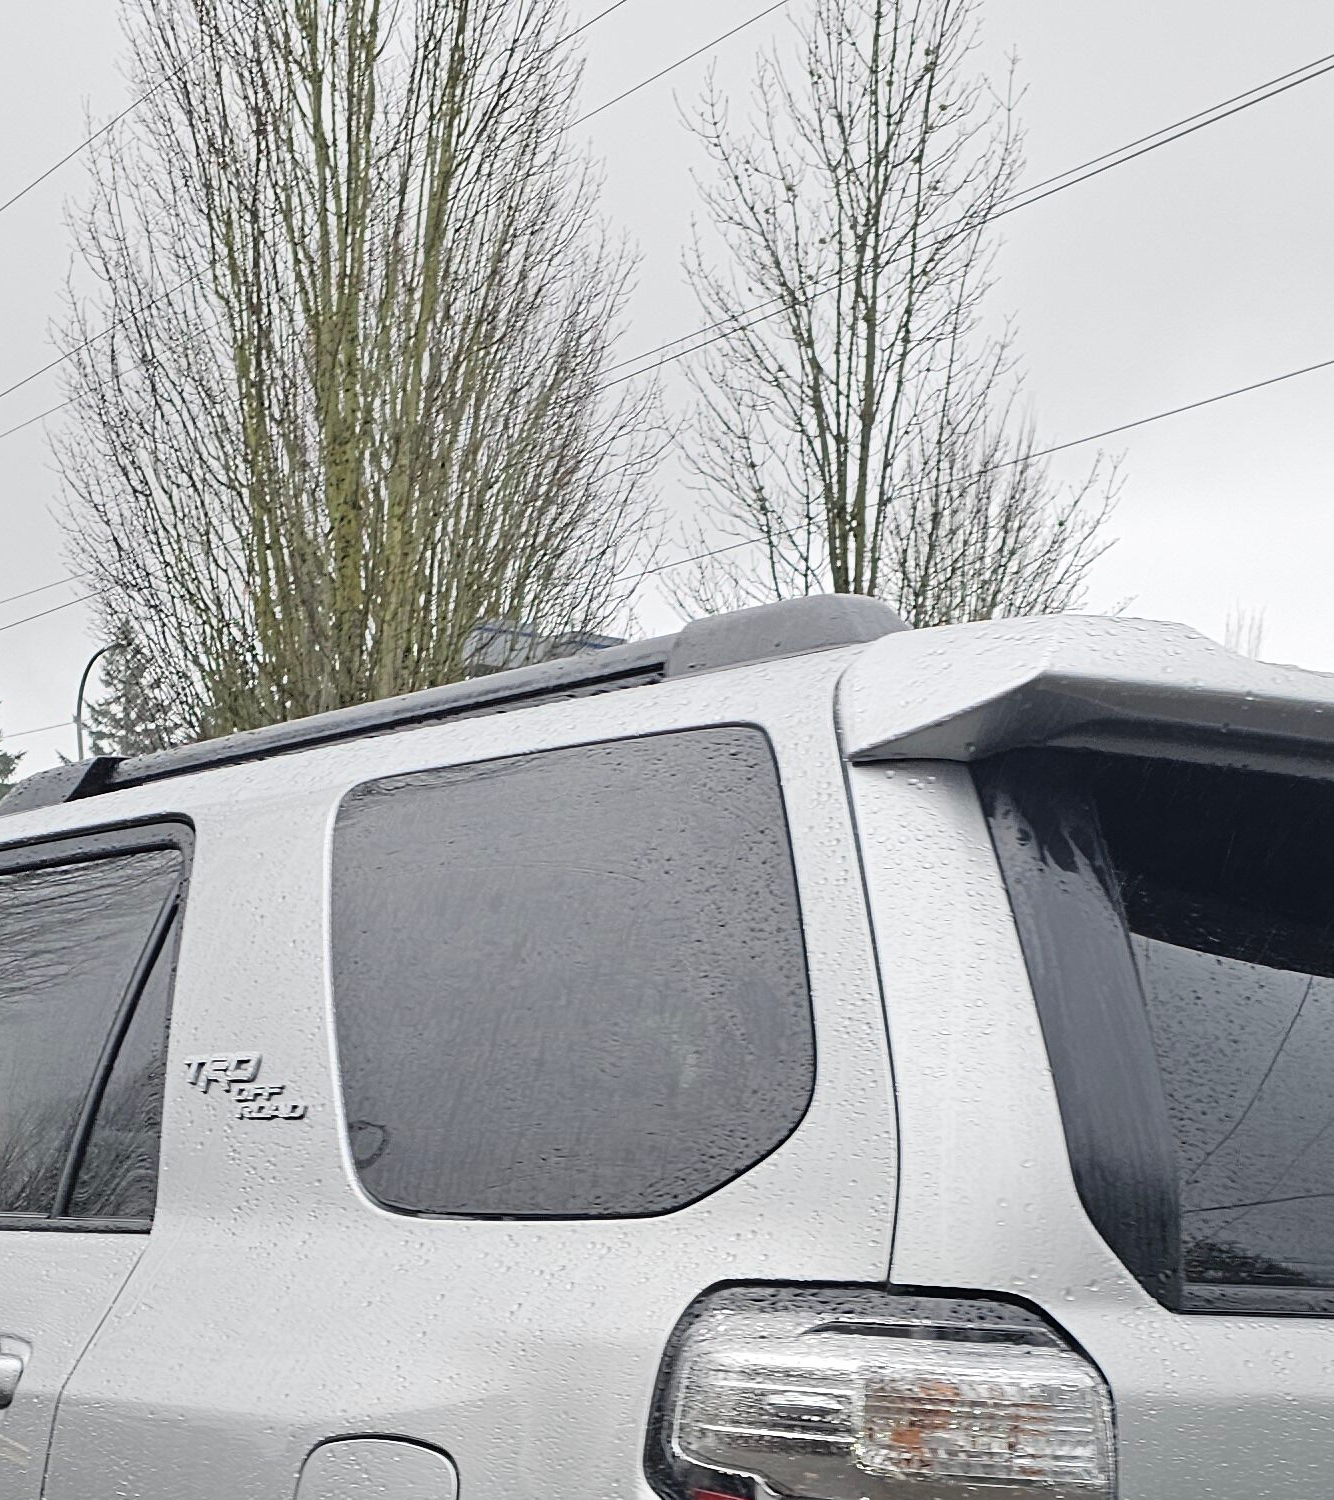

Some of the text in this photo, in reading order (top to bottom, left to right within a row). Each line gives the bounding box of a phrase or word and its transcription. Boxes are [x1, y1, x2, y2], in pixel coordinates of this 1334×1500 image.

[183, 1051, 263, 1094] TRD
[231, 1084, 286, 1102] OFF
[234, 1103, 308, 1120] ROAD
